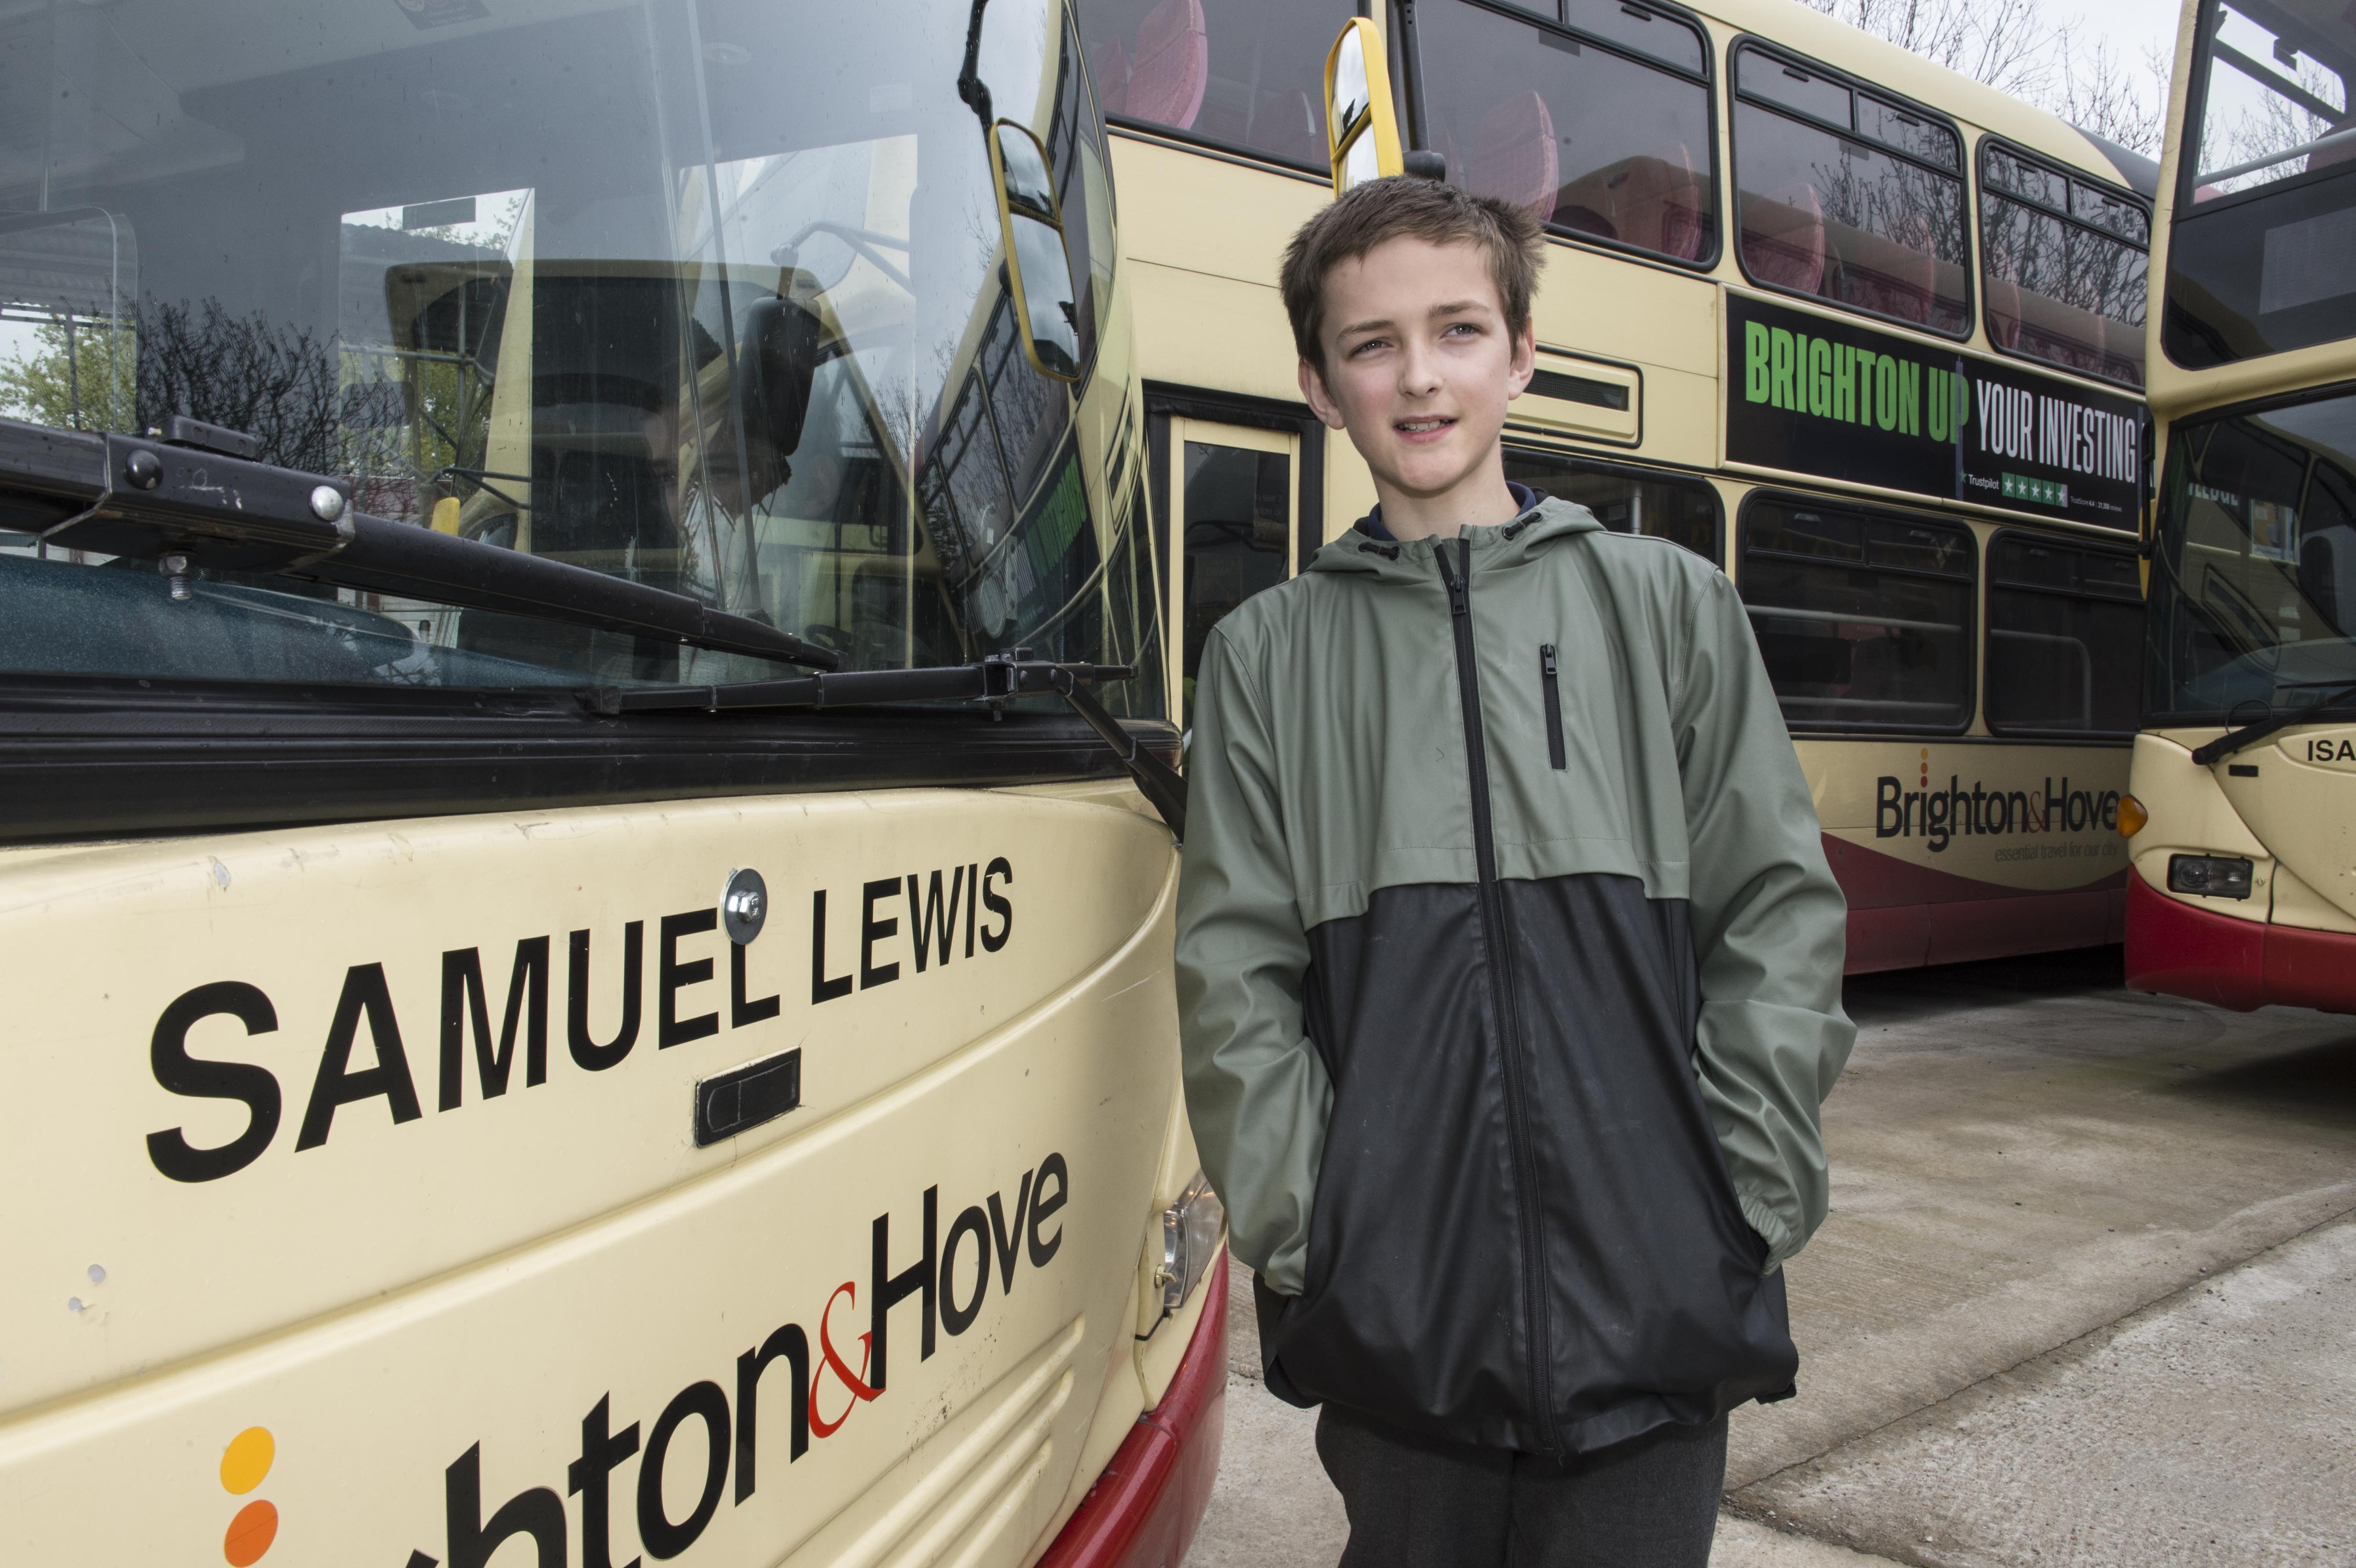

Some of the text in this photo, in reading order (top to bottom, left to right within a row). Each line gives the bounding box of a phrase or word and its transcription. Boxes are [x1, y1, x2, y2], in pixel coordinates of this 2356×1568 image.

[1745, 320, 1969, 445] BRIGHTON UP
[1976, 379, 2033, 461] YOUR
[2039, 395, 2136, 484] INVESTING
[1968, 474, 1999, 490] Trustpilot
[2308, 740, 2356, 762] ISA
[1995, 843, 2039, 862] essential
[2041, 842, 2067, 859] travel
[2068, 841, 2082, 858] for
[2084, 844, 2100, 857] our
[146, 856, 1013, 1183] SAMUEL LEWIS
